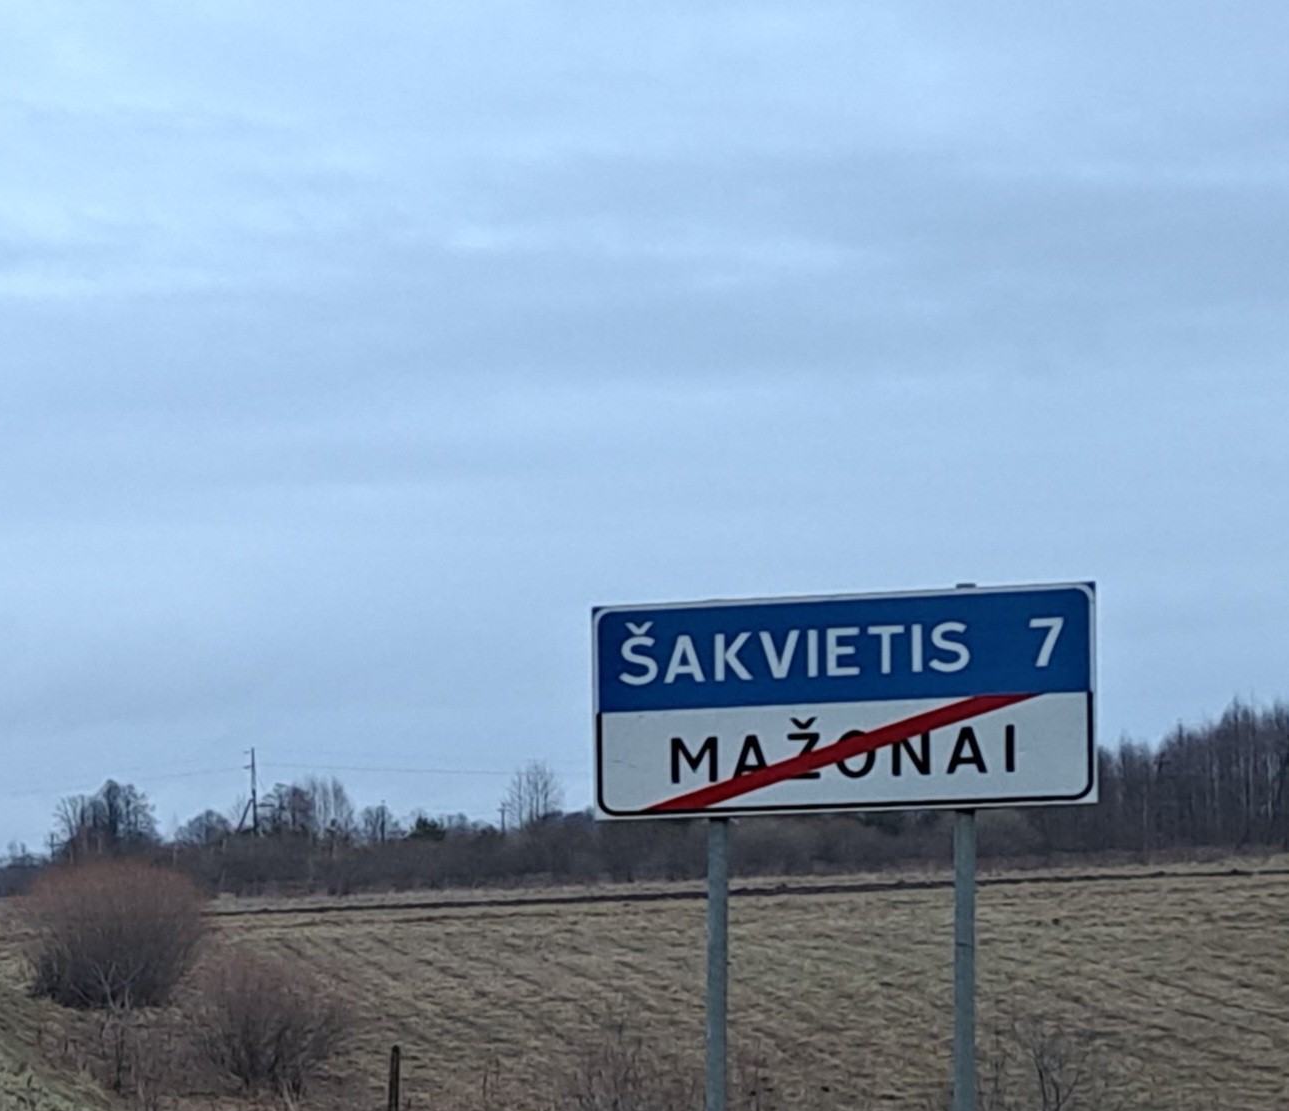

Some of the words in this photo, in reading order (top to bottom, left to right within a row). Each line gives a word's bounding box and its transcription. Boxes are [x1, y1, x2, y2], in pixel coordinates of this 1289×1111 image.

[618, 621, 971, 686] ŠAKVIETIS
[1028, 616, 1065, 668] 7
[670, 716, 1016, 784] MAŽONAI
